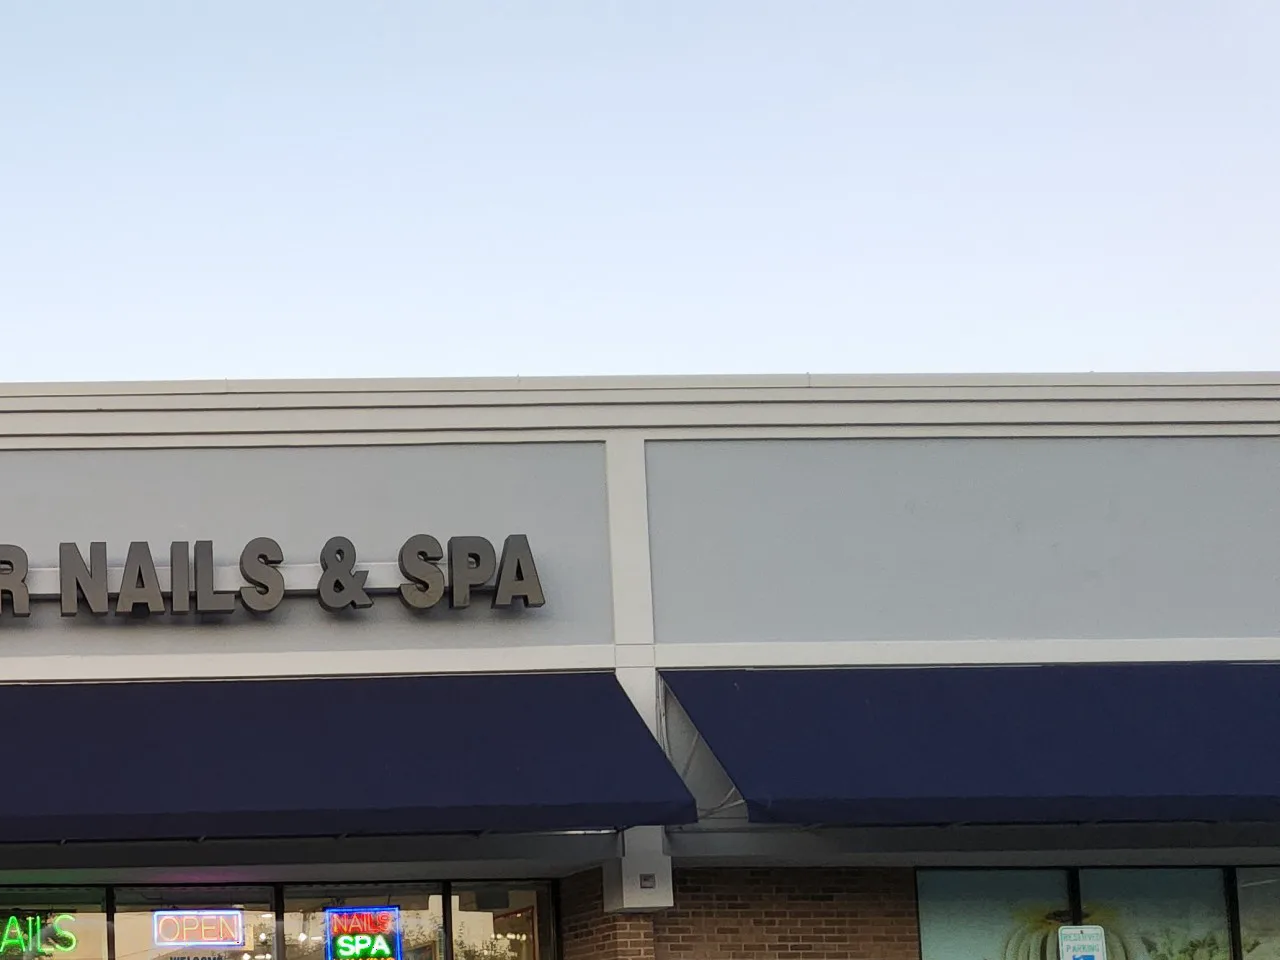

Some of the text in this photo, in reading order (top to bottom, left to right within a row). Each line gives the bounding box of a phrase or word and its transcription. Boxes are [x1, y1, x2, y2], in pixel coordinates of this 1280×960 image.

[59, 536, 285, 617] NAILS
[319, 536, 373, 611] &
[398, 533, 546, 609] SPA
[159, 915, 238, 941] OPEN
[331, 912, 393, 933] NAILS
[337, 935, 391, 956] SPA
